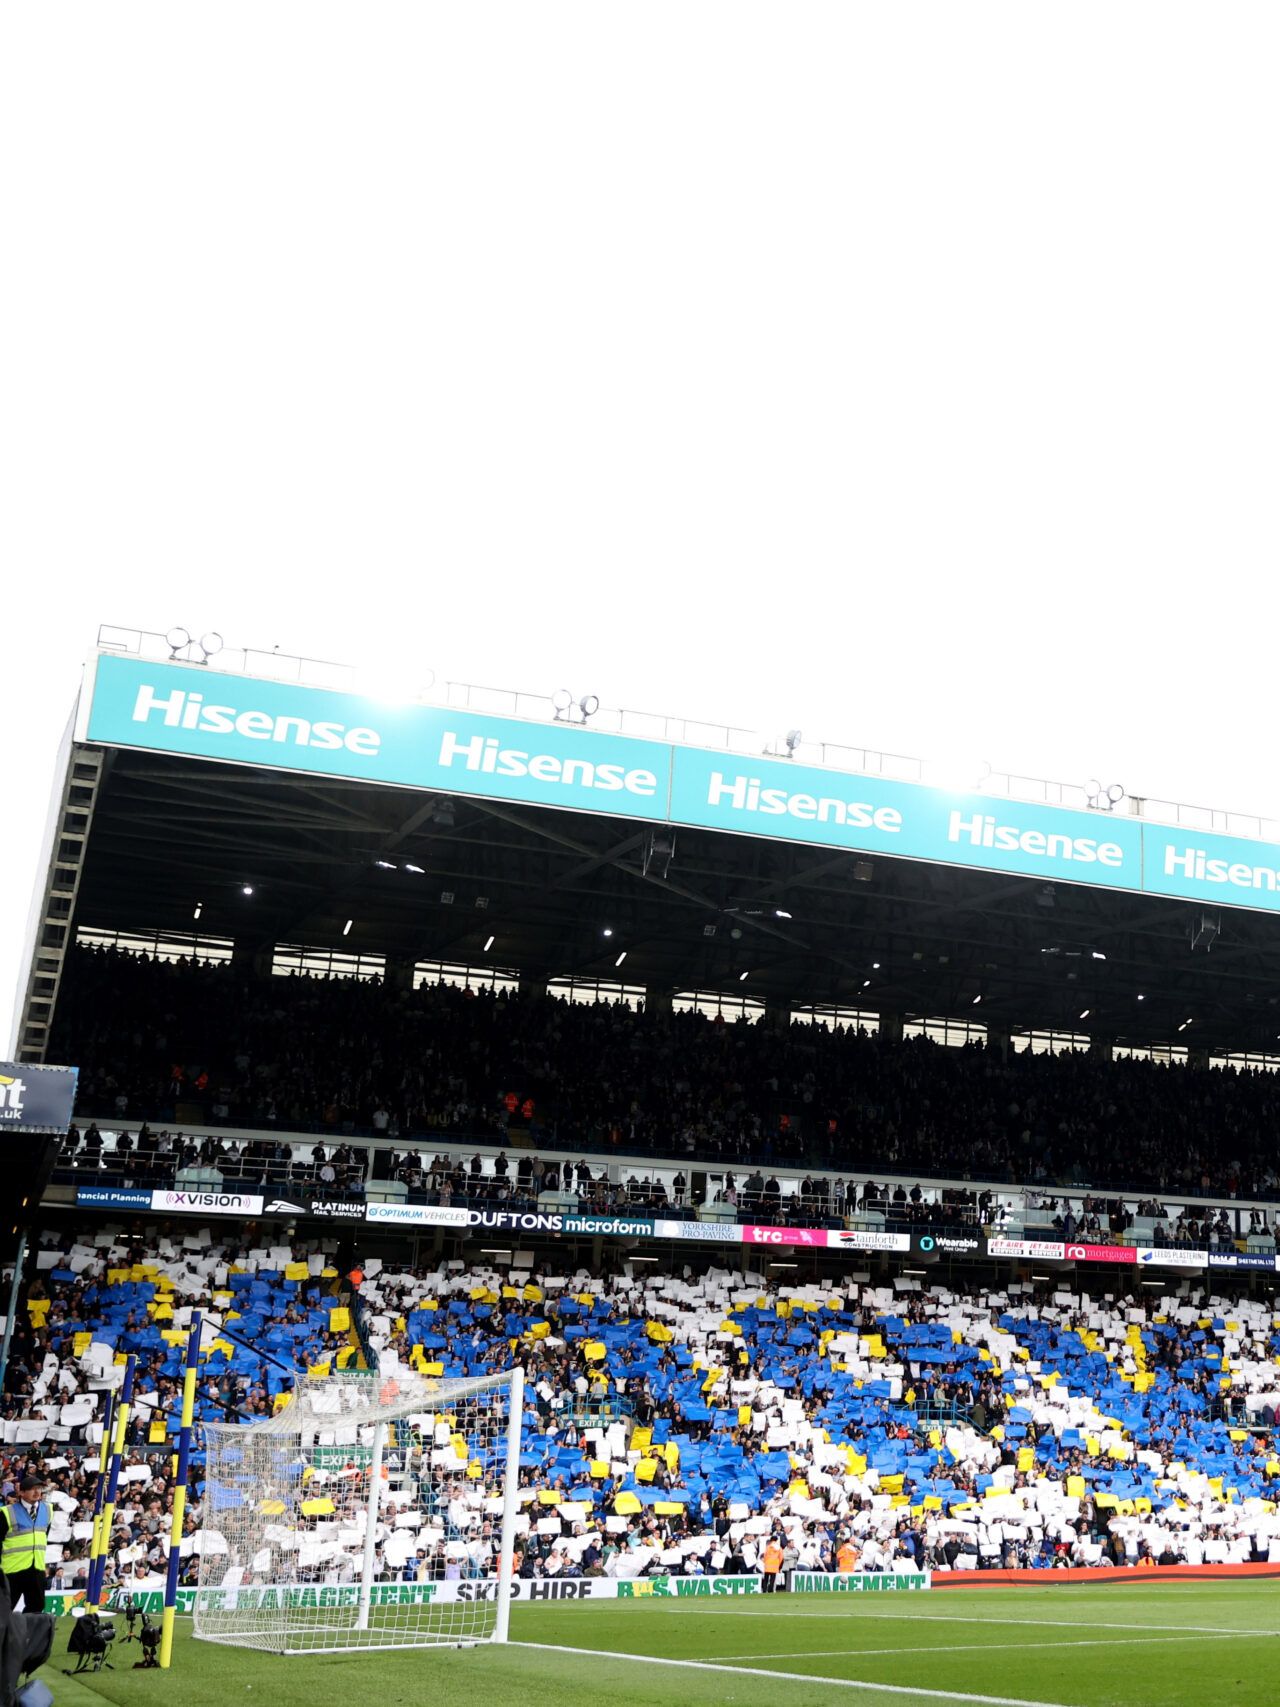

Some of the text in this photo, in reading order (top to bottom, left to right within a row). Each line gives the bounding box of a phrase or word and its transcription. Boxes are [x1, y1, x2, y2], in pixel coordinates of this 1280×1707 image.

[131, 684, 381, 756] Hisense
[438, 731, 657, 795] Hisense
[707, 771, 902, 832] Hisense
[948, 810, 1123, 866] Hisense
[111, 1193, 151, 1204] Planning
[311, 1201, 366, 1213] PLATINUM
[379, 1208, 466, 1221] OPTIMUM VEHICLES
[468, 1210, 562, 1230] DUFTONS
[565, 1217, 651, 1235] microform
[683, 1222, 733, 1233] YORKSHIRE
[682, 1230, 735, 1240] PRO-PAVING
[752, 1227, 783, 1242] trc
[844, 1242, 893, 1250] CONSTRUCTION
[935, 1236, 978, 1248] Wearable
[1086, 1248, 1134, 1261] mortgages
[1154, 1250, 1171, 1258] LEEDS
[1172, 1251, 1206, 1260] PLASTERING
[580, 1419, 597, 1428] EXIT
[320, 1455, 351, 1466] EXIT
[676, 1578, 759, 1597] WASTE
[794, 1574, 926, 1592] MANAGEMENT
[530, 1581, 592, 1600] HIRE
